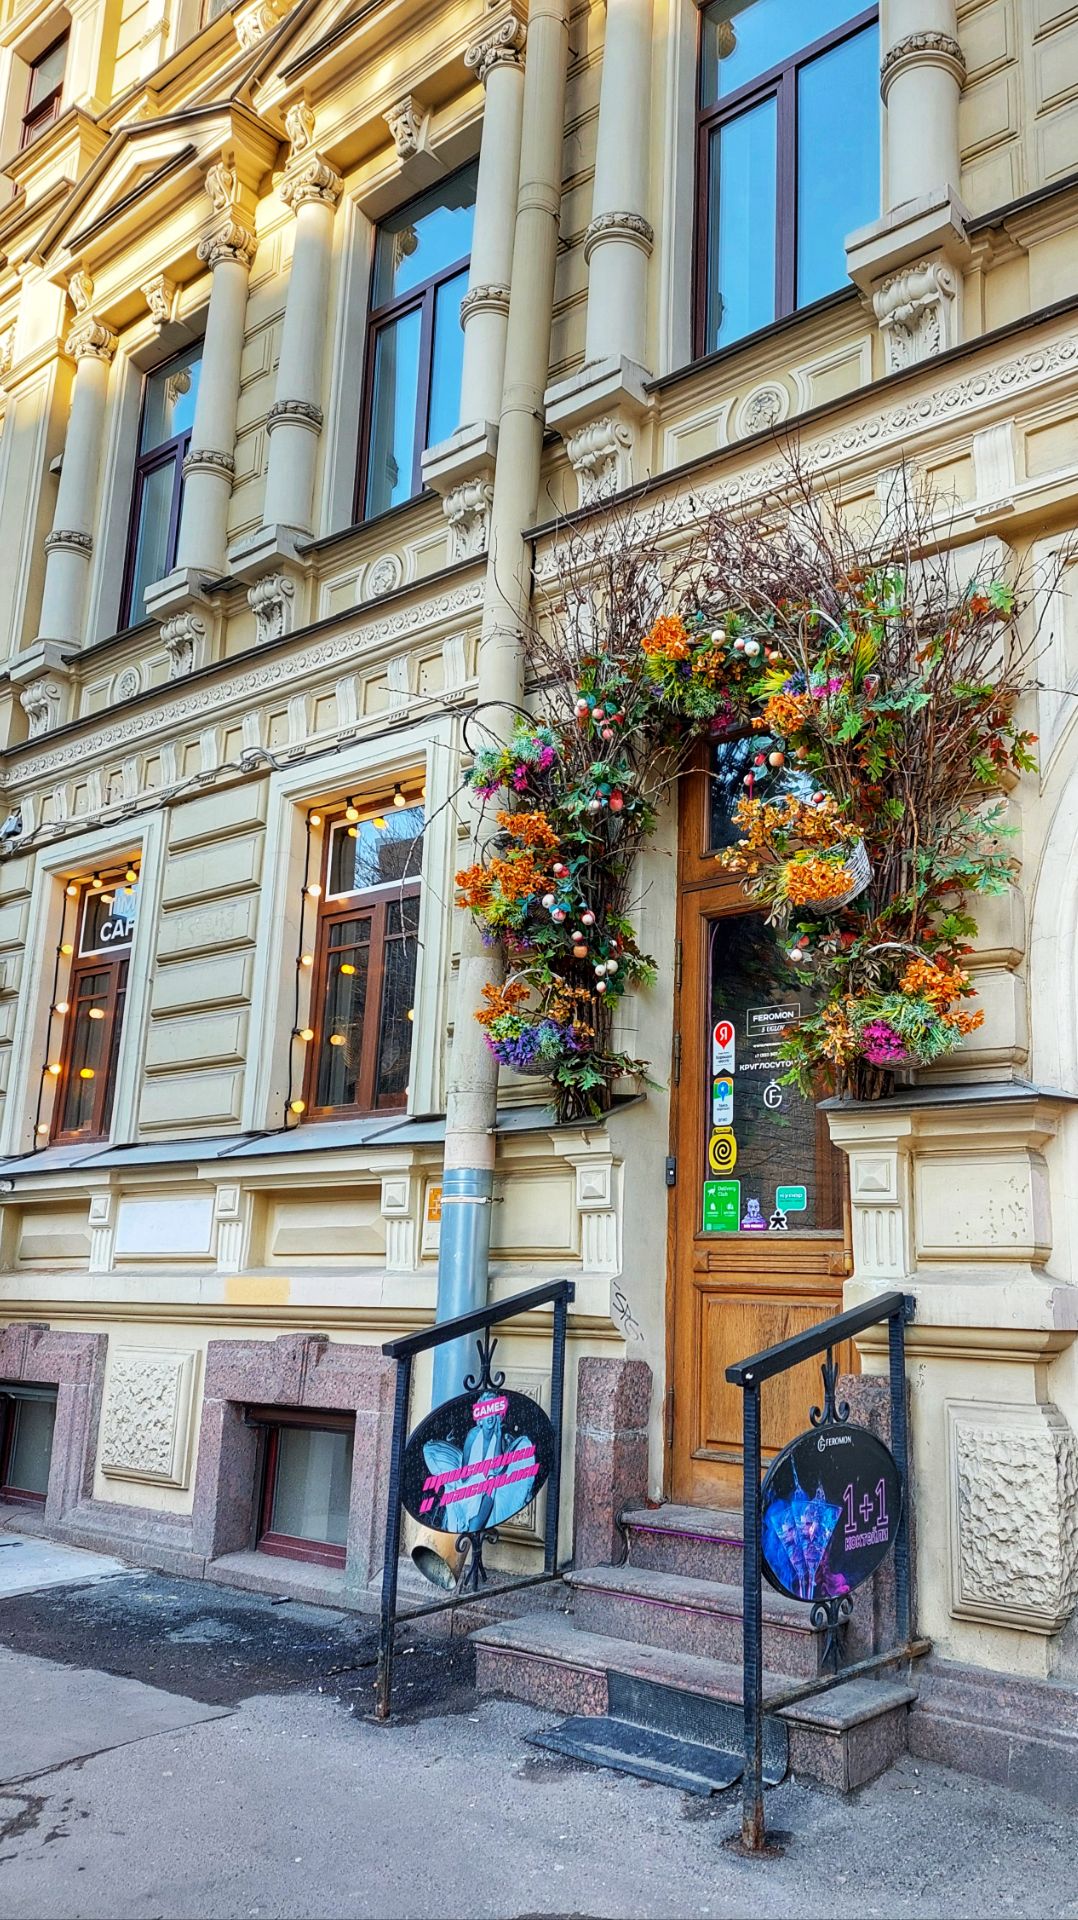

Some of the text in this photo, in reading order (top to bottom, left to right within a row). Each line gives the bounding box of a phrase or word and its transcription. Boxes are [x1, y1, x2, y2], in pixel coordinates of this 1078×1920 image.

[752, 1011, 795, 1023] FEROMON
[719, 1026, 728, 1041] Я
[473, 1400, 506, 1418] GAMES
[825, 1435, 852, 1447] FEROMON
[422, 1444, 537, 1493] приставки
[842, 1478, 889, 1533] 1+1
